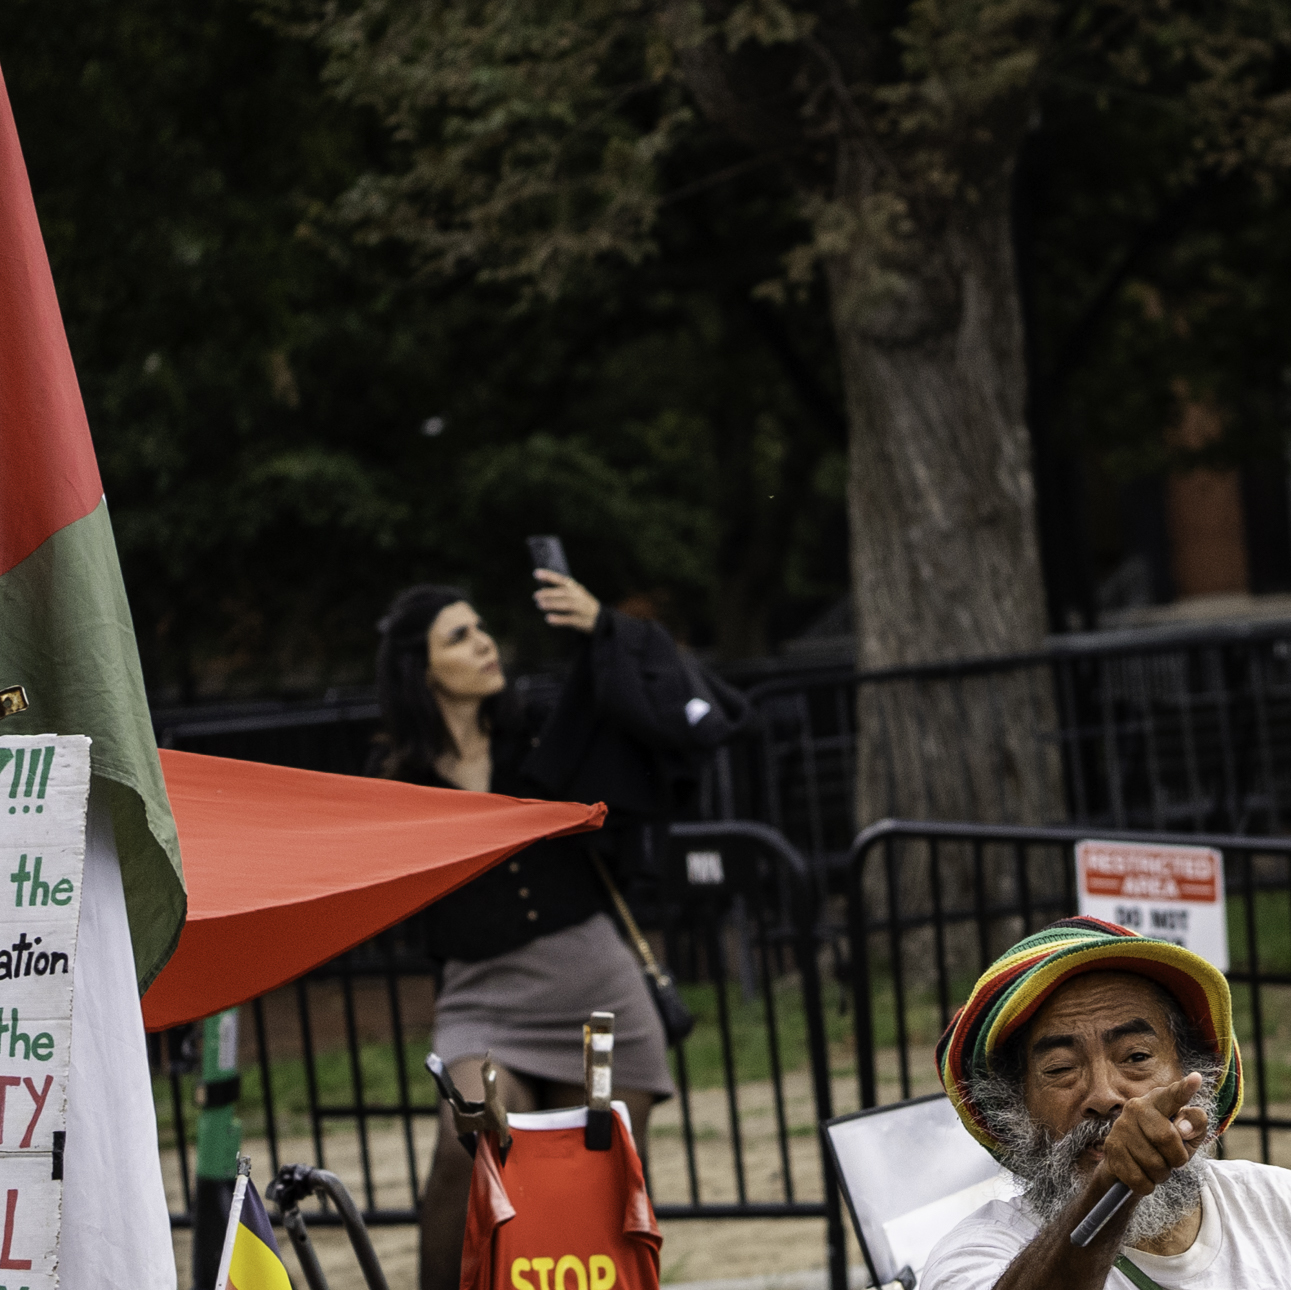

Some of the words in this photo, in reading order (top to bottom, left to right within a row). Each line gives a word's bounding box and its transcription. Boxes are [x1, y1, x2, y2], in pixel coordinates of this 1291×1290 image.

[10, 853, 74, 907] the
[1114, 906, 1143, 927] DO
[1150, 908, 1188, 930] NOT
